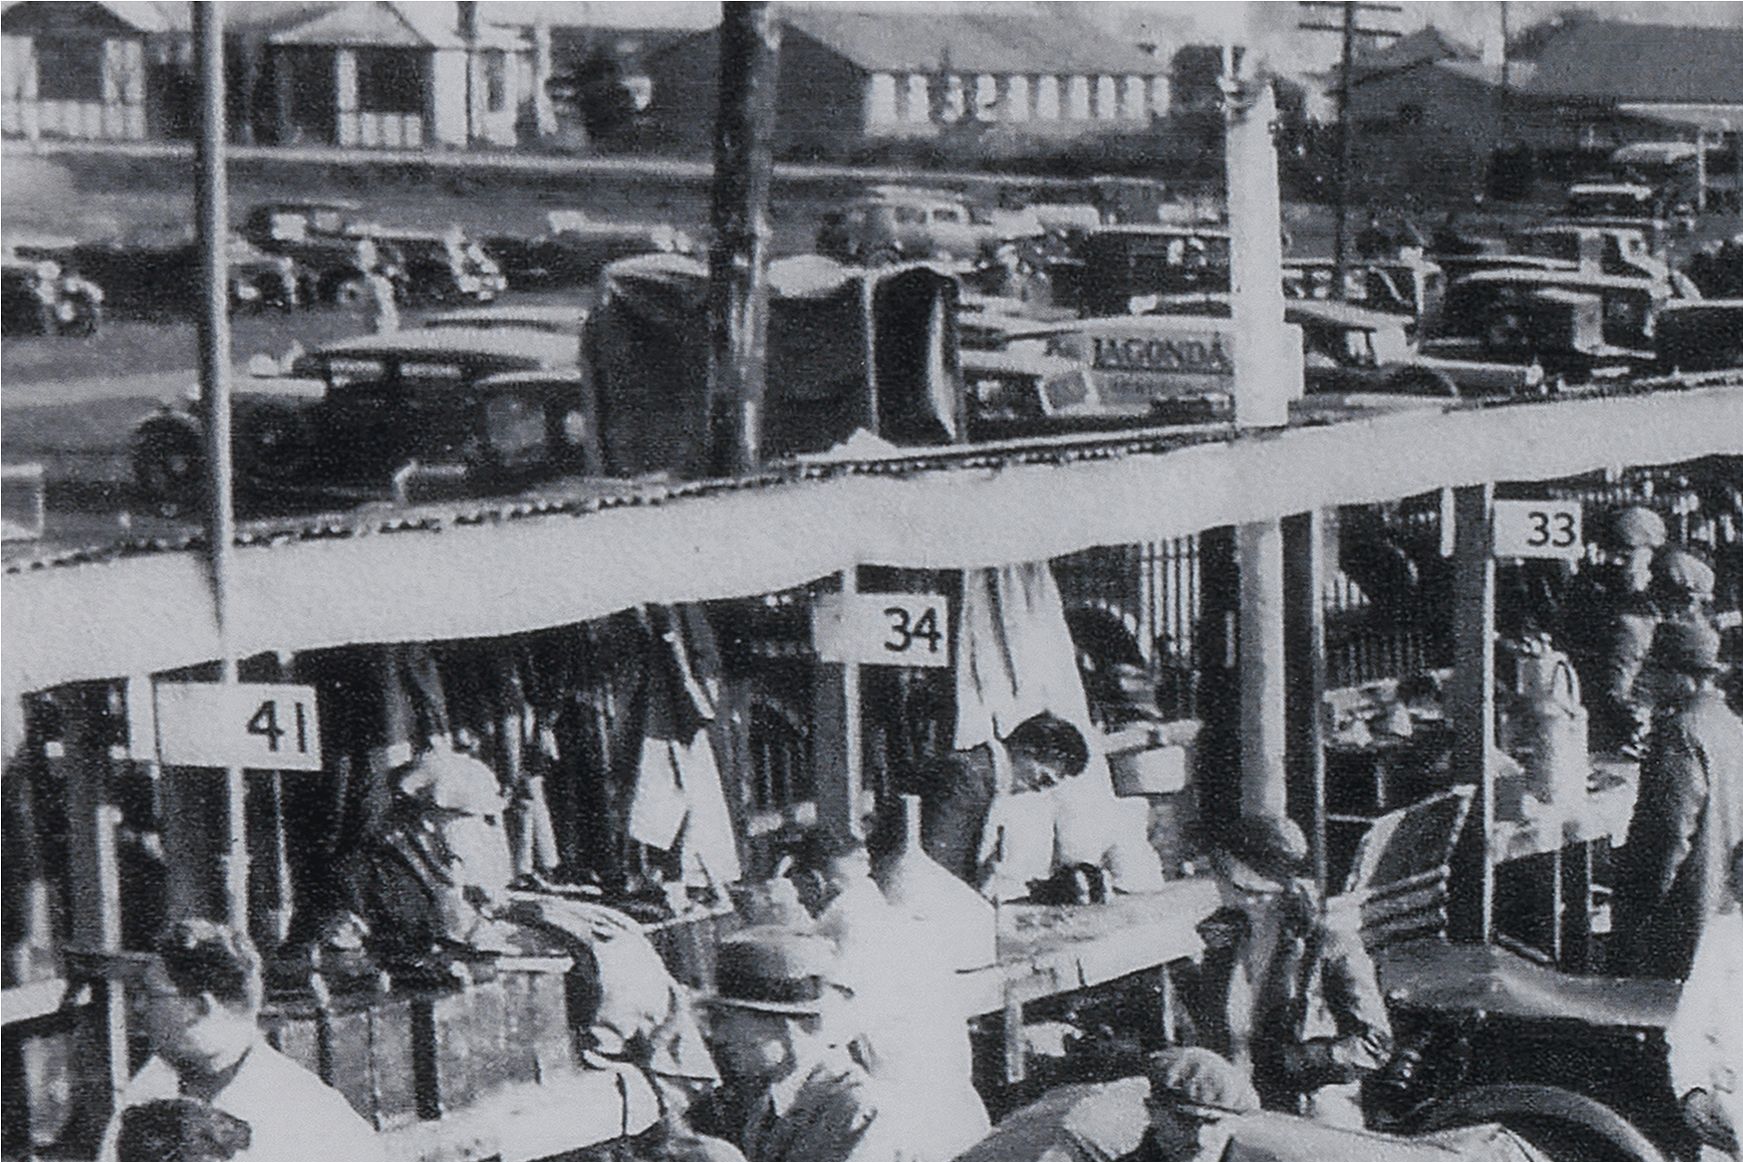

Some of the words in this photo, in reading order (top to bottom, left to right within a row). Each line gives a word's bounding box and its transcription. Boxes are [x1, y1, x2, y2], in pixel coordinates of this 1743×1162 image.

[1526, 511, 1576, 548] 33
[883, 607, 942, 653] 34
[247, 700, 307, 754] 41
